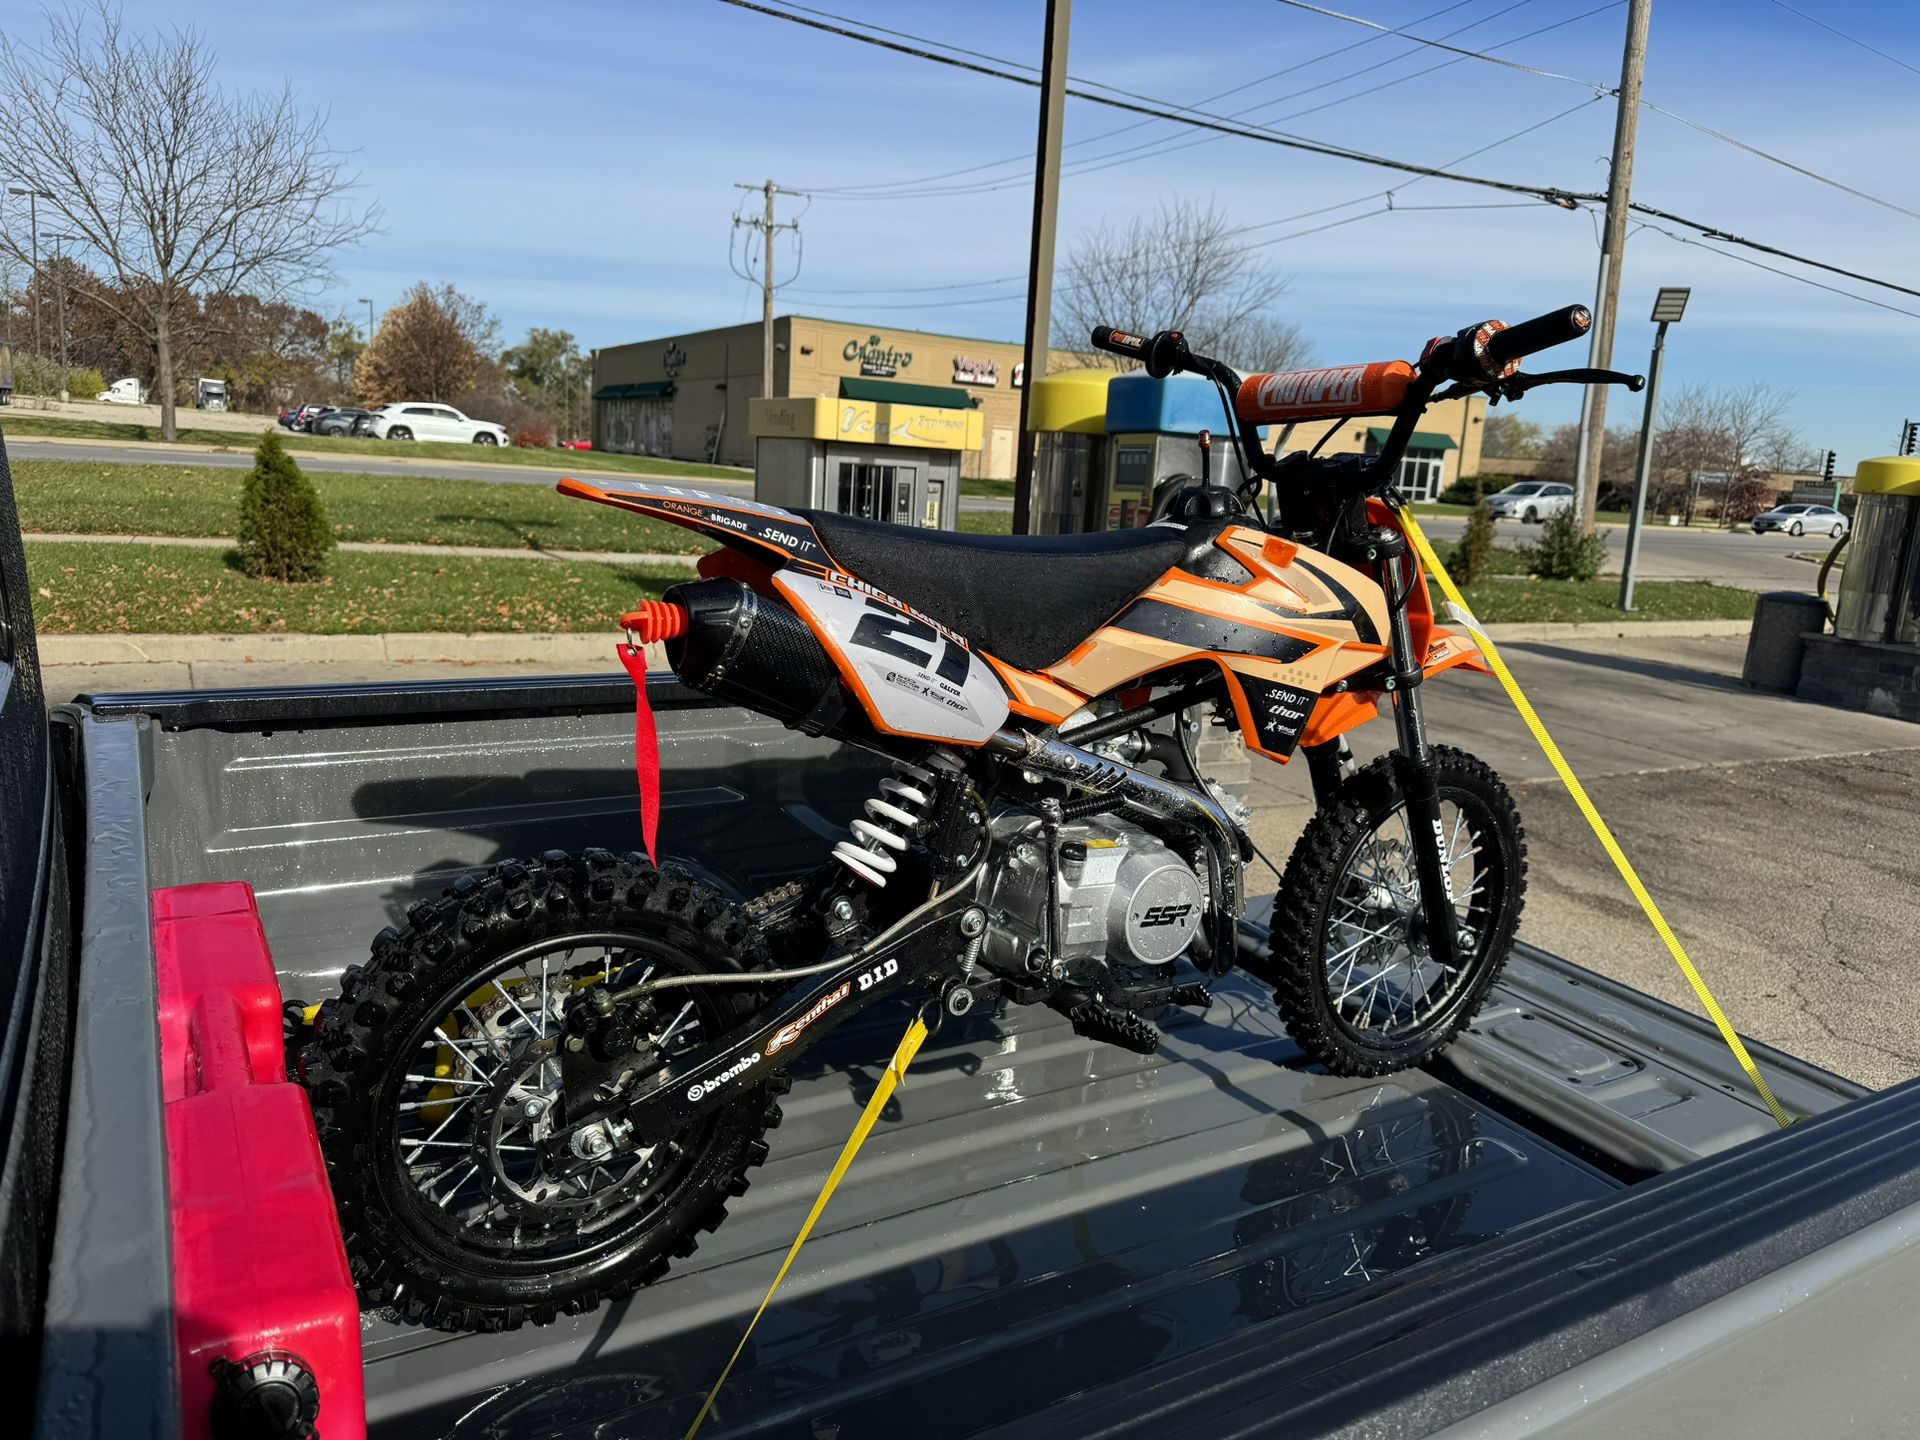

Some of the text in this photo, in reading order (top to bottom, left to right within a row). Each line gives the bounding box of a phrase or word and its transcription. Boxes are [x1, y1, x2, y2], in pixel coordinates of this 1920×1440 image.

[1259, 366, 1366, 406] PROTAPER
[711, 513, 748, 531] BRIGADE
[1268, 704, 1305, 720] thor
[1139, 903, 1192, 928] SSR
[703, 1052, 761, 1094] brembo
